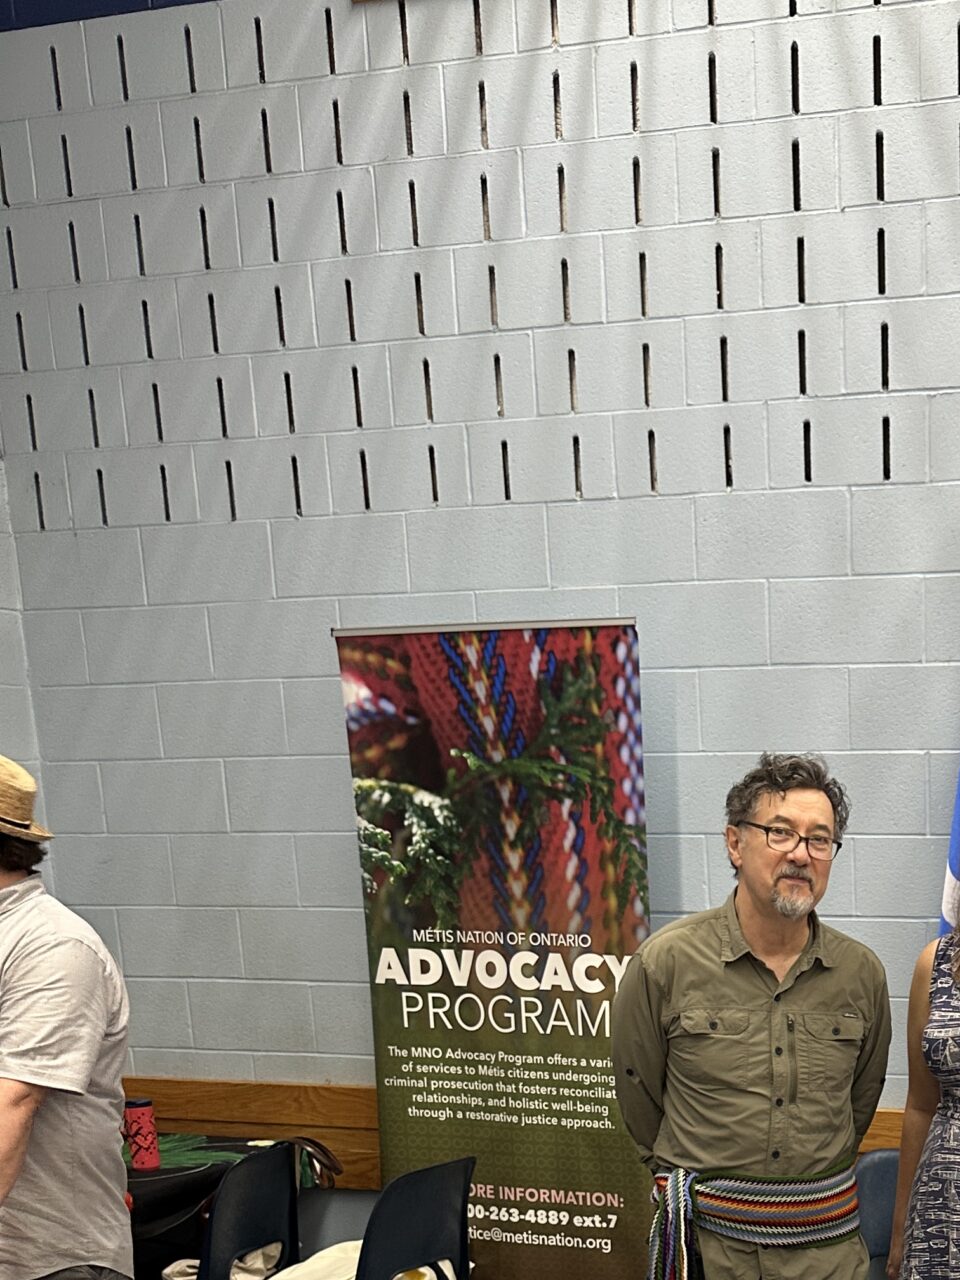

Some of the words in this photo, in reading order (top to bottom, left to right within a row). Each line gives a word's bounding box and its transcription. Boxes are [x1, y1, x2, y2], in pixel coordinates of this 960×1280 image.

[412, 927, 454, 943] MÉTIS
[456, 930, 503, 945] NATION
[506, 931, 526, 945] OF
[529, 932, 592, 948] ONTARIO
[375, 947, 633, 993] ADVOCACY
[401, 992, 610, 1037] PROGRAM
[387, 1045, 408, 1057] The
[411, 1047, 442, 1058] MNO
[445, 1048, 496, 1064] Advocacy
[498, 1051, 544, 1066] Program
[547, 1053, 577, 1066] offers
[580, 1059, 587, 1067] a
[589, 1057, 613, 1068] vari
[401, 1061, 414, 1072] of
[416, 1063, 462, 1074] services
[464, 1065, 476, 1075] to
[478, 1064, 505, 1077] Métis
[507, 1067, 550, 1080] citizens
[552, 1070, 616, 1086] undergoing
[384, 1076, 428, 1088] criminal
[430, 1079, 494, 1091] prosecution
[495, 1081, 517, 1093] that
[518, 1082, 557, 1095] fosters
[559, 1087, 617, 1099] reconciliat
[412, 1092, 486, 1107] relationships,
[487, 1096, 506, 1107] and
[508, 1096, 549, 1110] holistic
[551, 1100, 609, 1117] well-being
[408, 1106, 453, 1120] through
[456, 1110, 463, 1119] a
[465, 1111, 519, 1123] restorative
[521, 1113, 558, 1127] justice
[560, 1118, 616, 1130] approach.
[469, 1183, 495, 1199] ORE
[499, 1186, 625, 1208] INFORMATION:
[467, 1203, 570, 1225] 00-263-4889
[573, 1213, 618, 1229] ext.7
[468, 1225, 612, 1254] tice@metisnation.org
